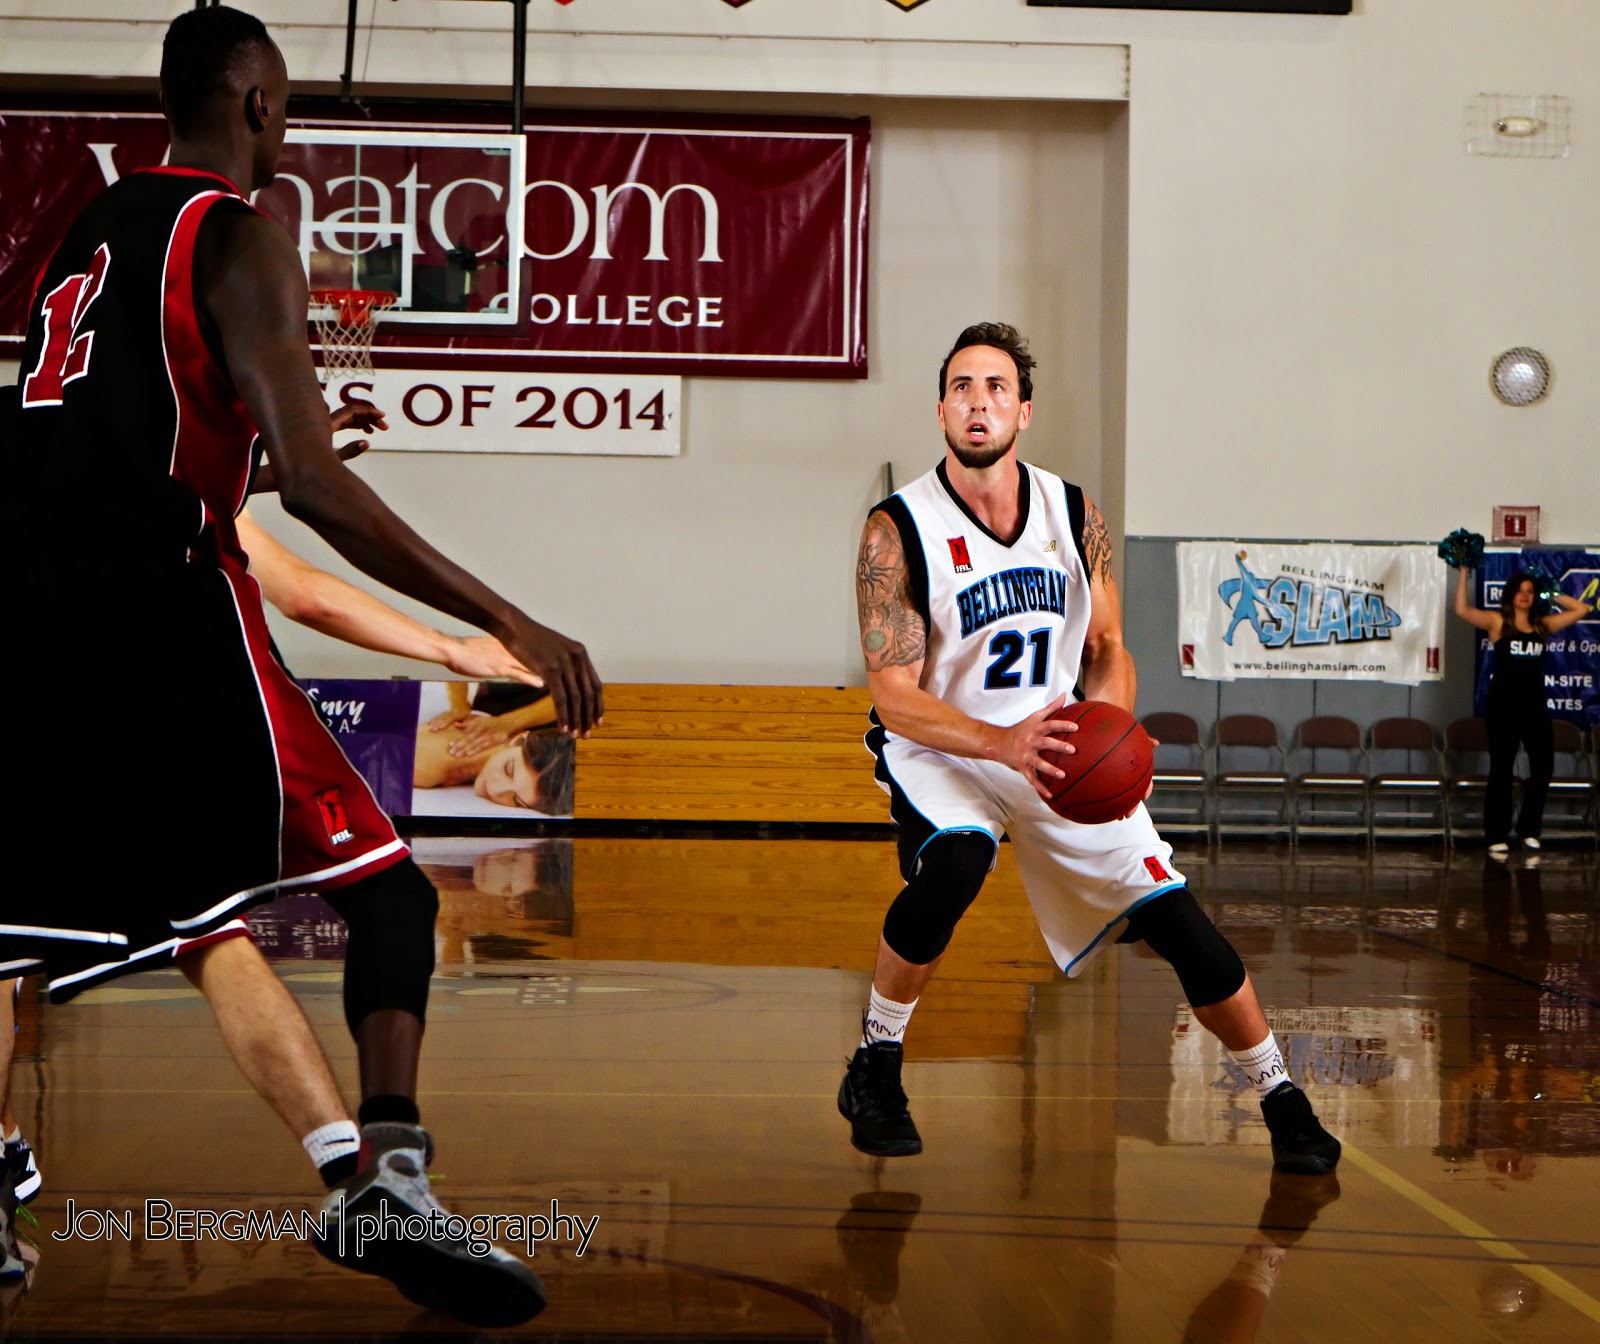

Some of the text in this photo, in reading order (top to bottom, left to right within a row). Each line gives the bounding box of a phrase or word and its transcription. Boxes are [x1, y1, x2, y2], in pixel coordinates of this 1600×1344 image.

[401, 383, 496, 427] OF
[514, 386, 669, 431] 2014
[1281, 563, 1386, 592] BELLINGHAM
[1262, 575, 1392, 650] SLAM
[984, 626, 1053, 691] 21
[1233, 659, 1387, 673] www.bellinghamslam.com
